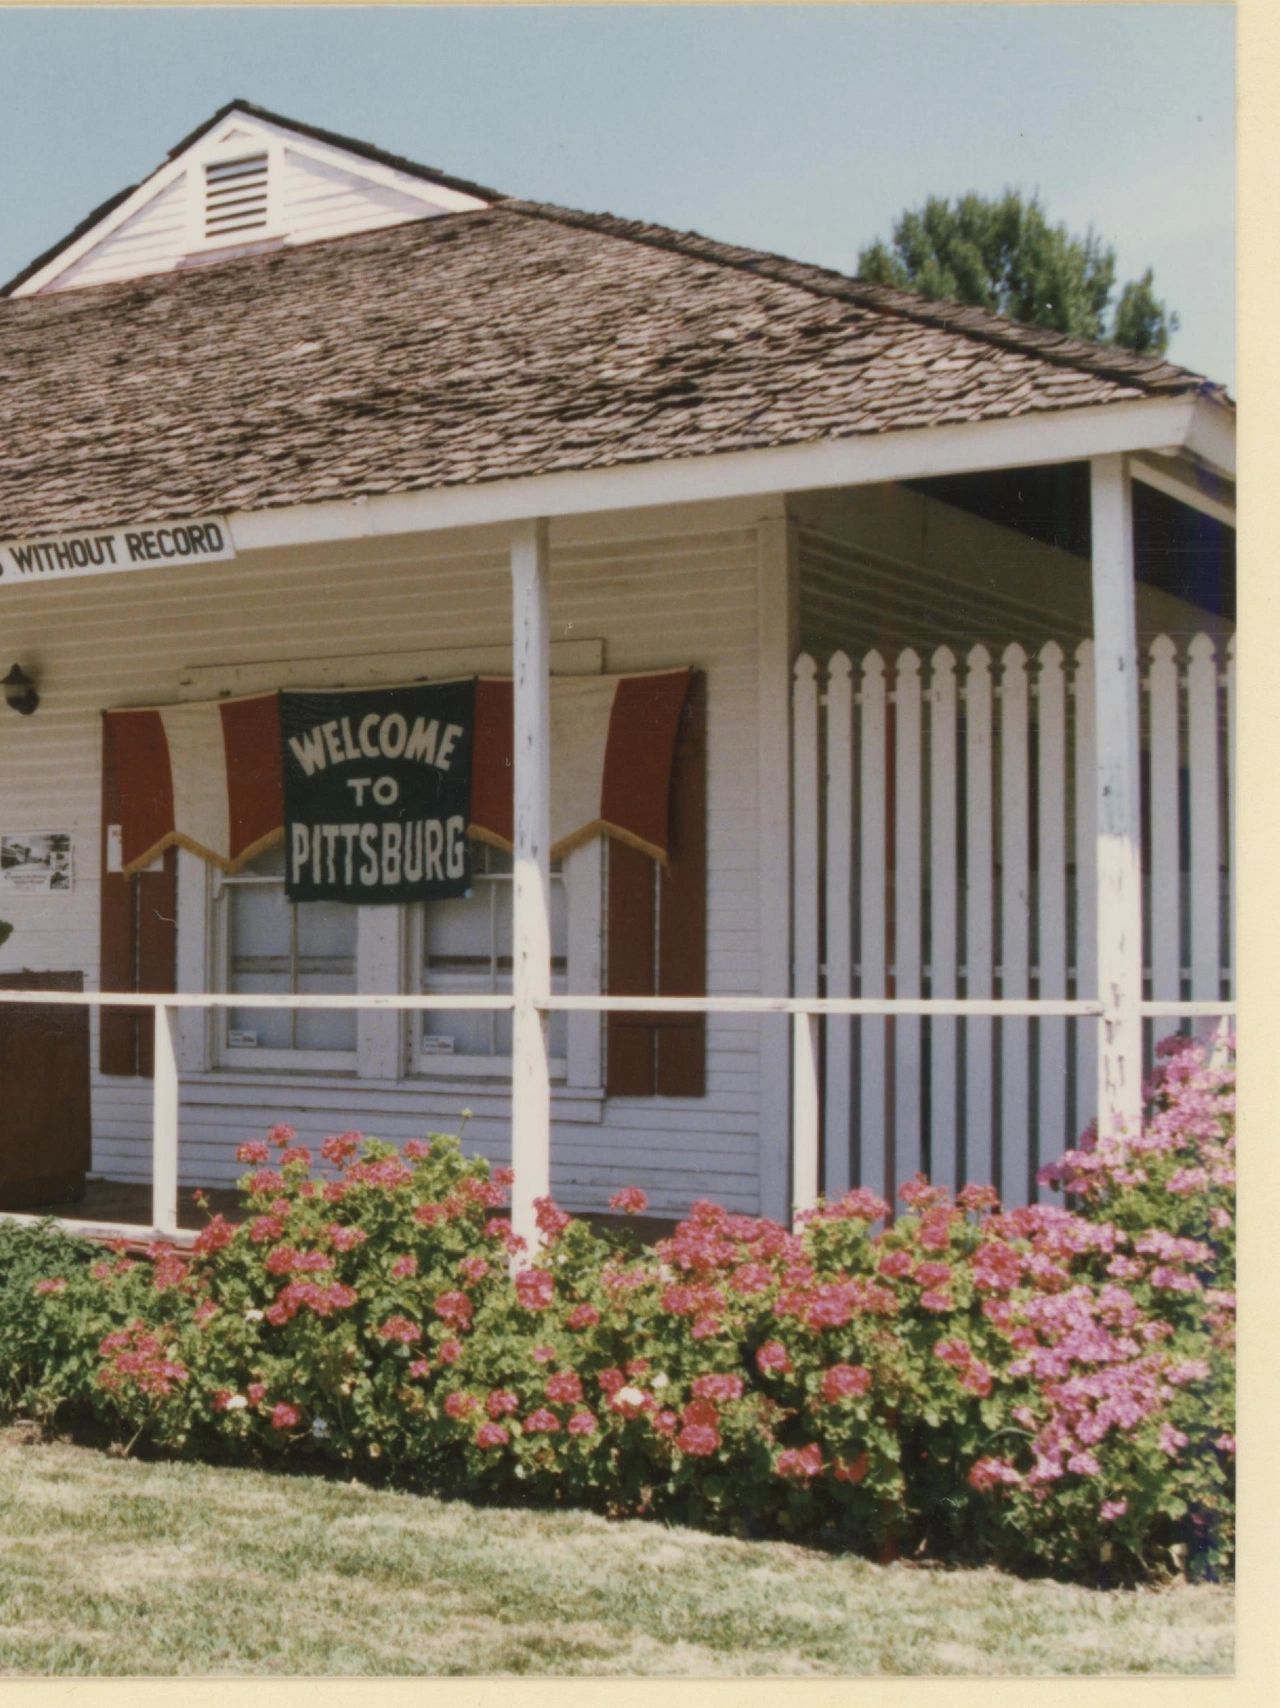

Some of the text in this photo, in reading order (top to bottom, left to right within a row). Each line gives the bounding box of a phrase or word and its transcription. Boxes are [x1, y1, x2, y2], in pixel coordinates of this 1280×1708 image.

[9, 535, 121, 574] WITHOUT
[124, 522, 225, 562] RECORD
[288, 712, 465, 777] WELCOME
[346, 775, 400, 807] TO
[291, 815, 466, 887] PITTSBURG
